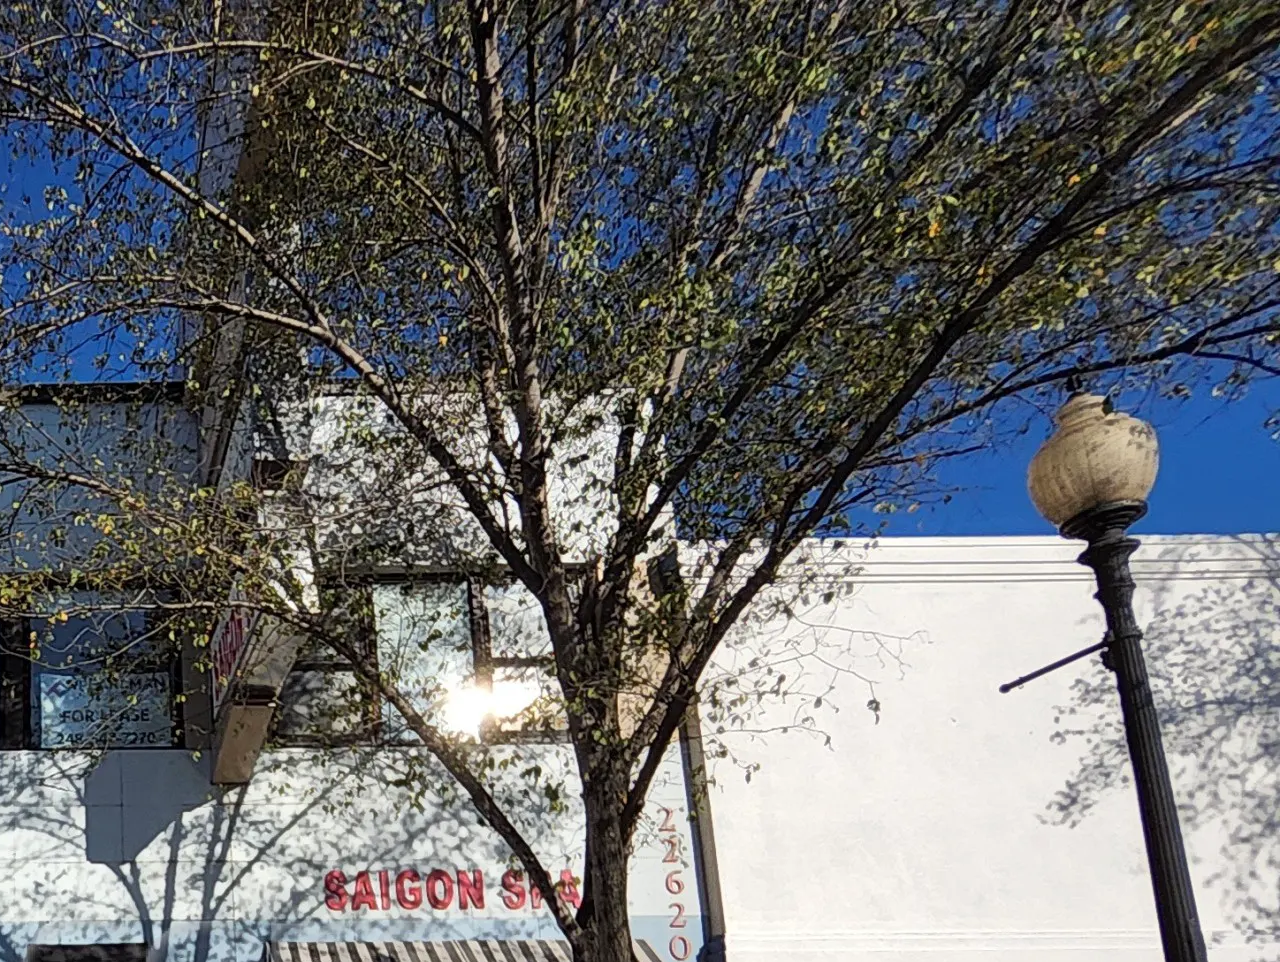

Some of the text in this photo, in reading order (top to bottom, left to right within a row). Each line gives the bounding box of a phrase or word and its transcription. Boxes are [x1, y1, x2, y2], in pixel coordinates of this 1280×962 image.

[61, 709, 96, 723] FOR
[323, 868, 485, 911] SAIGON
[657, 807, 691, 961] 22620
